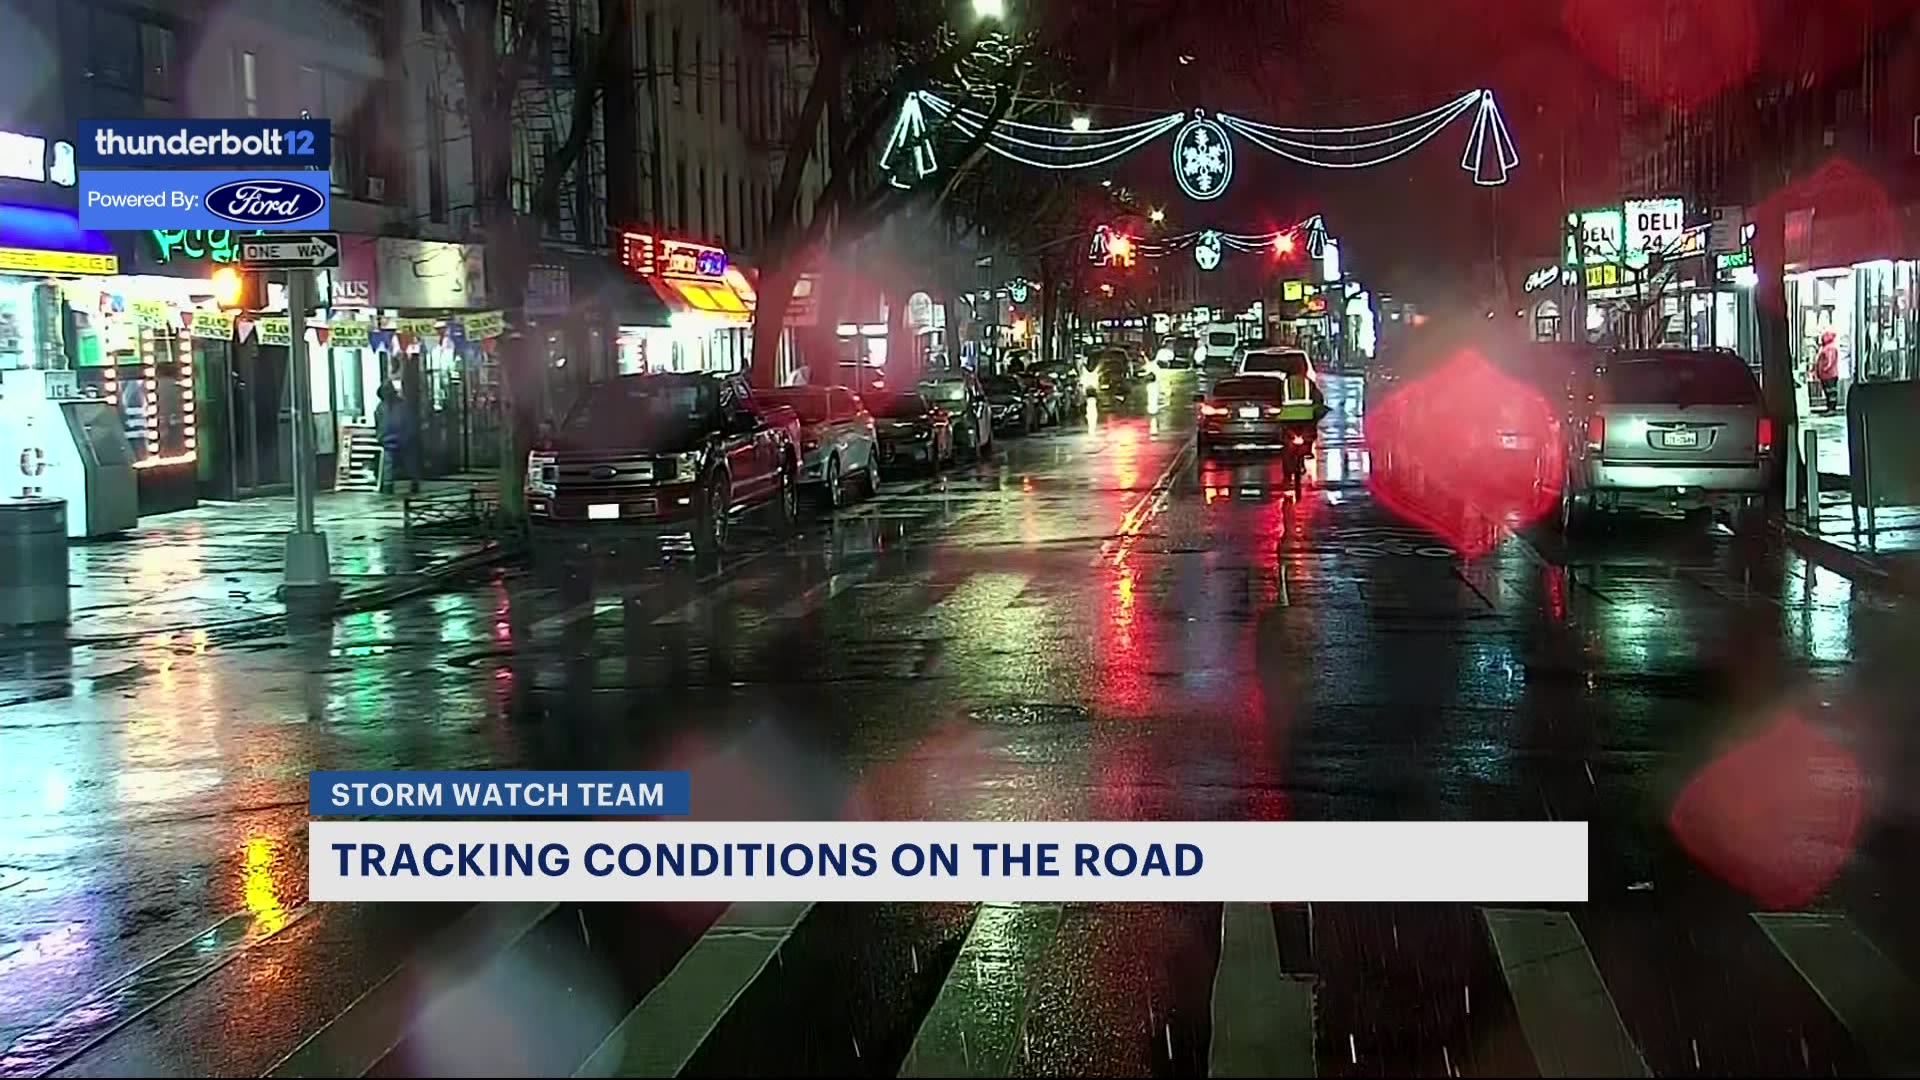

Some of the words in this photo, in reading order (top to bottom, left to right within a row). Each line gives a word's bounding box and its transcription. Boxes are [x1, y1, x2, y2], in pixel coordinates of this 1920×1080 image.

[1638, 213, 1678, 231] DELI
[1581, 226, 1614, 242] DELI
[248, 242, 281, 259] ONE
[297, 244, 328, 259] WAY
[1642, 235, 1664, 252] 24
[51, 384, 70, 397] ICE
